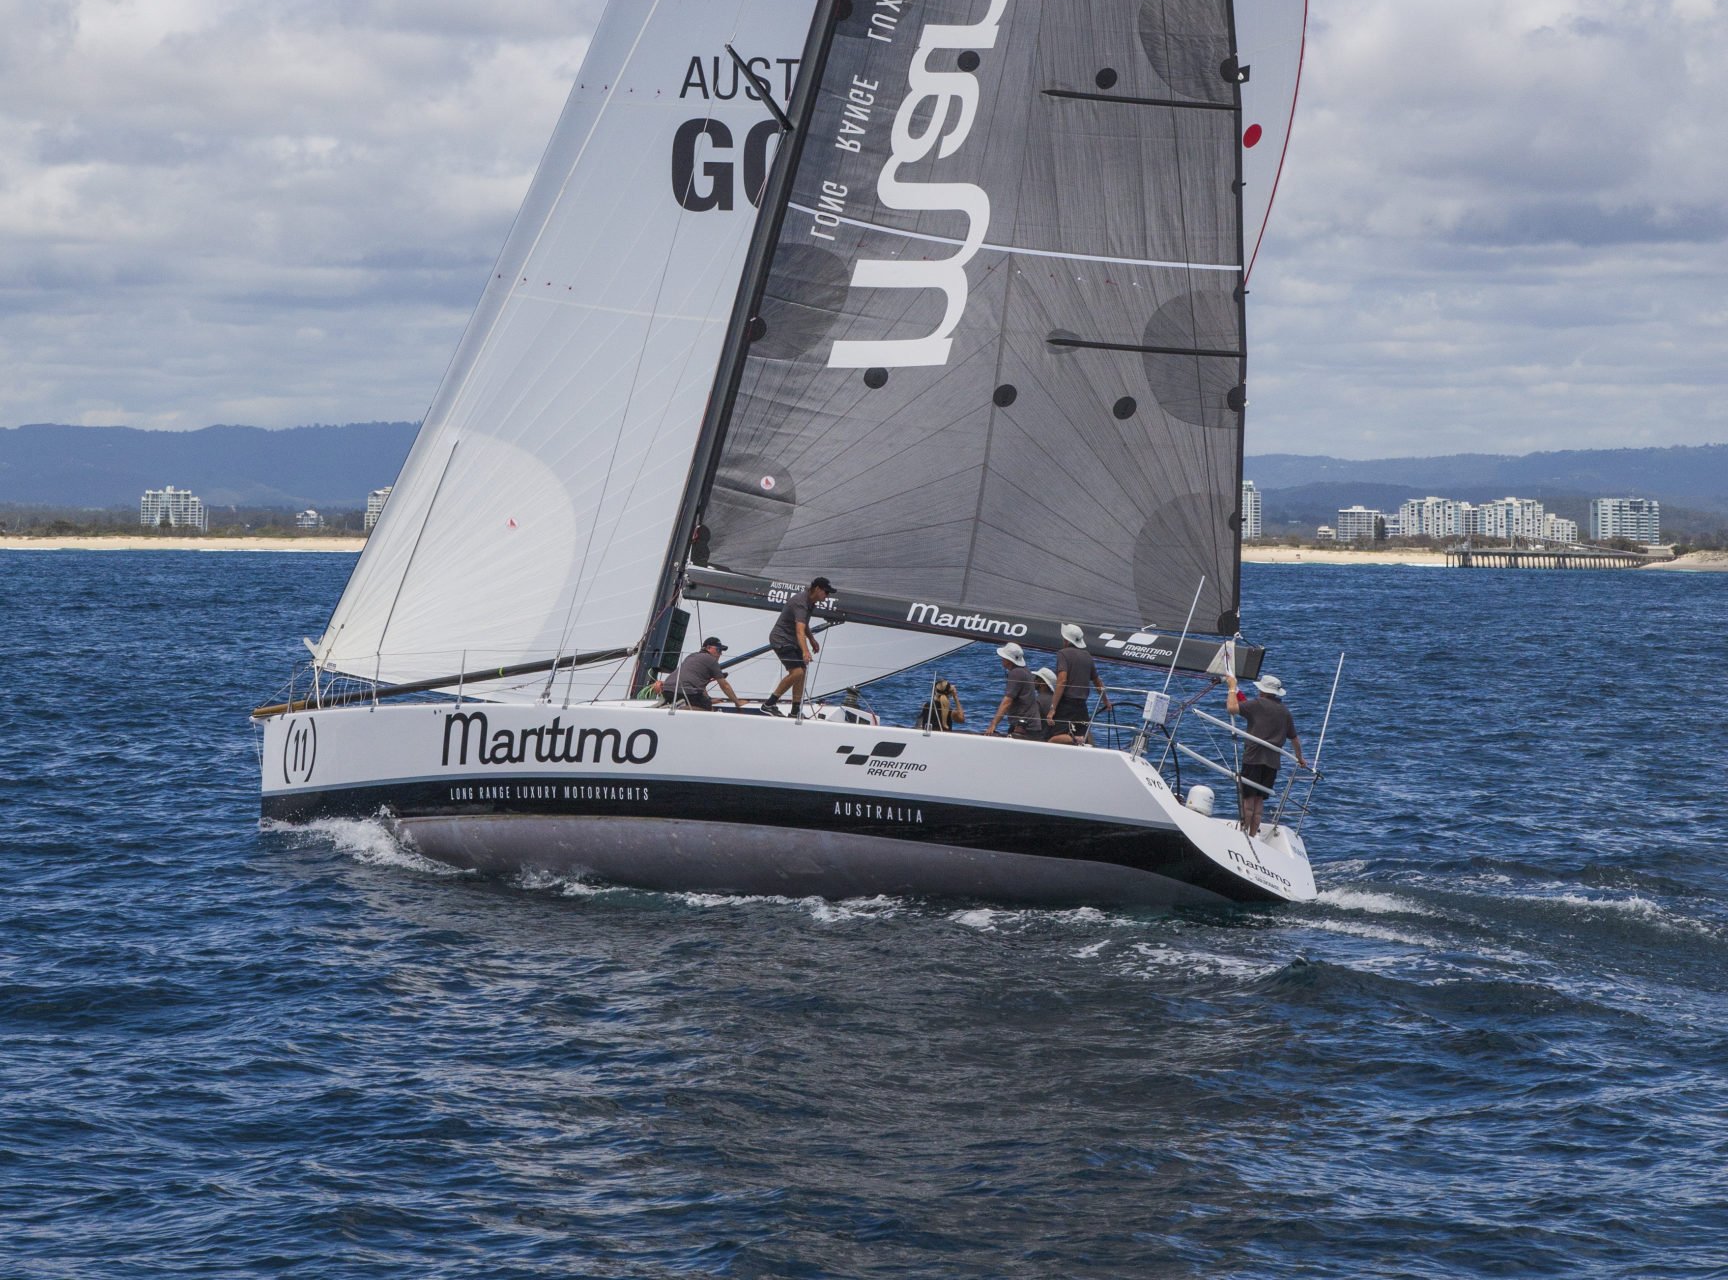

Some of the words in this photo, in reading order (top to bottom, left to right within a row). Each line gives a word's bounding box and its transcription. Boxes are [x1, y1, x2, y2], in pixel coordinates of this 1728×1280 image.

[770, 581, 805, 592] AUSTRALIA'S
[906, 602, 1028, 637] Maritimo
[1122, 650, 1157, 660] RACING
[1125, 644, 1173, 656] MARITIMO
[441, 711, 658, 766] Maritimo
[869, 759, 927, 772] MARITIMO
[867, 768, 908, 779] RACING
[450, 788, 473, 800] LONG
[479, 787, 510, 799] RANGE
[516, 786, 557, 799] LUXURY
[564, 786, 649, 801] MOTORYACHTS
[834, 801, 923, 823] AUSTRALIA
[1228, 849, 1291, 887] Maritimo
